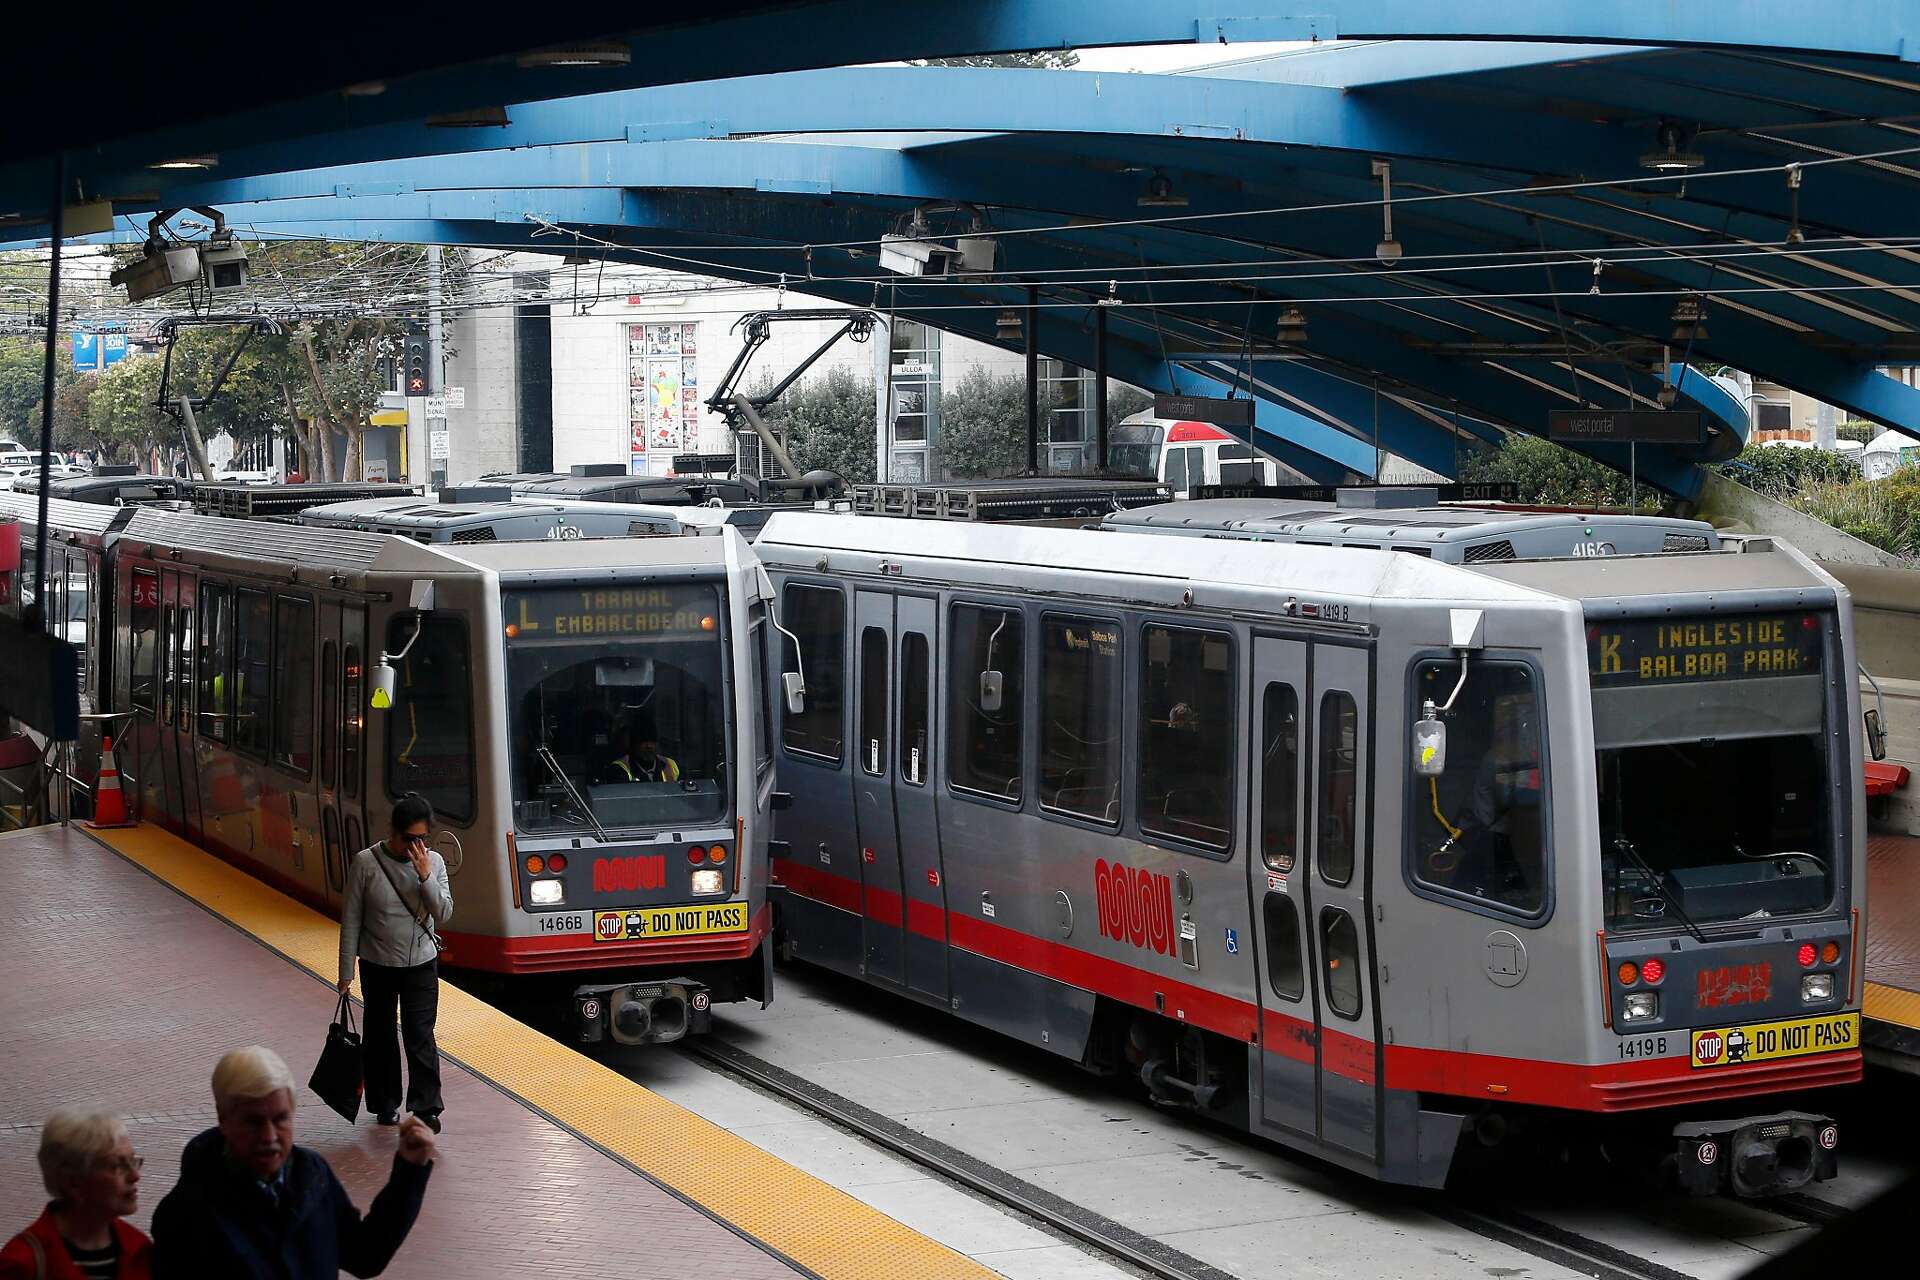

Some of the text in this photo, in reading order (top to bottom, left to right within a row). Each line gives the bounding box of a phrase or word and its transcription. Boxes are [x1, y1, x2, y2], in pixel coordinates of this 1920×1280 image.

[1570, 415, 1615, 435] west portal
[1222, 489, 1255, 499] EXIT
[1302, 490, 1324, 498] WEST
[1463, 485, 1492, 498] EXIT
[582, 590, 673, 609] TARAVAL
[519, 600, 539, 630] L
[1323, 604, 1340, 620] 1419
[555, 611, 700, 634] EMBARCADERO
[1658, 620, 1785, 649] INGLESIDE
[1600, 634, 1623, 673] K
[1640, 648, 1799, 678] BALBOA PARK
[539, 916, 583, 932] 1466B
[600, 918, 621, 934] STOP
[653, 913, 671, 932] DO
[676, 911, 703, 931] NOT
[707, 909, 740, 928] PASS
[1756, 1030, 1776, 1054] DO
[1781, 1025, 1811, 1050] NOT
[1815, 1020, 1851, 1046] PASS
[1618, 1038, 1653, 1058] 1419
[1698, 1038, 1722, 1058] STOP
